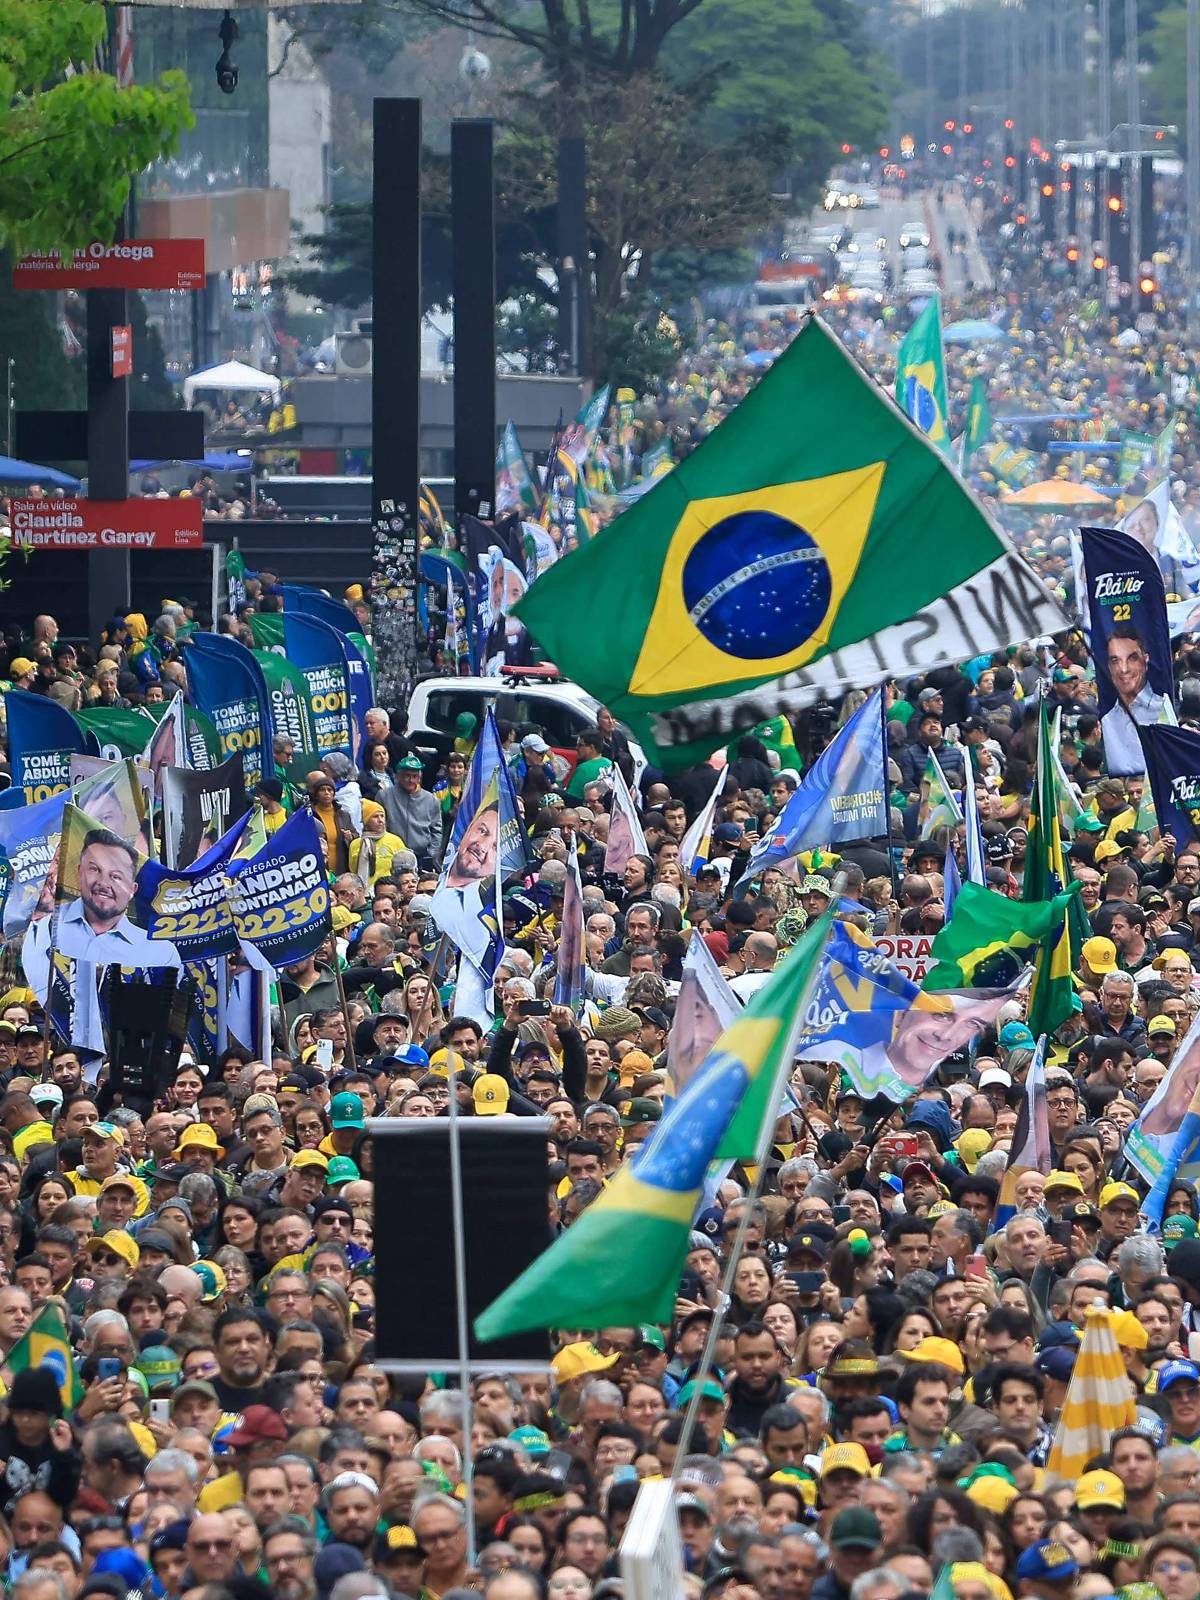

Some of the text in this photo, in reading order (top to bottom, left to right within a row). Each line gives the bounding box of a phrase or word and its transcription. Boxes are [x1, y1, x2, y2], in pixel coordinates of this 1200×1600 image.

[90, 242, 154, 261] Ortega
[14, 500, 77, 510] Sala de vídeo
[14, 512, 84, 528] Claudia
[14, 528, 156, 546] Martínez Garay
[693, 583, 728, 616] ORDEM
[743, 550, 817, 576] PROGRESSO
[1095, 573, 1145, 598] Flávio
[1113, 604, 1131, 621] 22
[310, 677, 346, 692] BDUCH
[212, 702, 246, 719] TOMÉ
[311, 690, 347, 713] 001
[215, 711, 260, 731] ABDUCH
[22, 752, 61, 767] TOMÉ
[23, 767, 70, 781] ABDUC
[24, 784, 69, 806] 100
[163, 871, 226, 900] SAND
[153, 903, 233, 939] 2223
